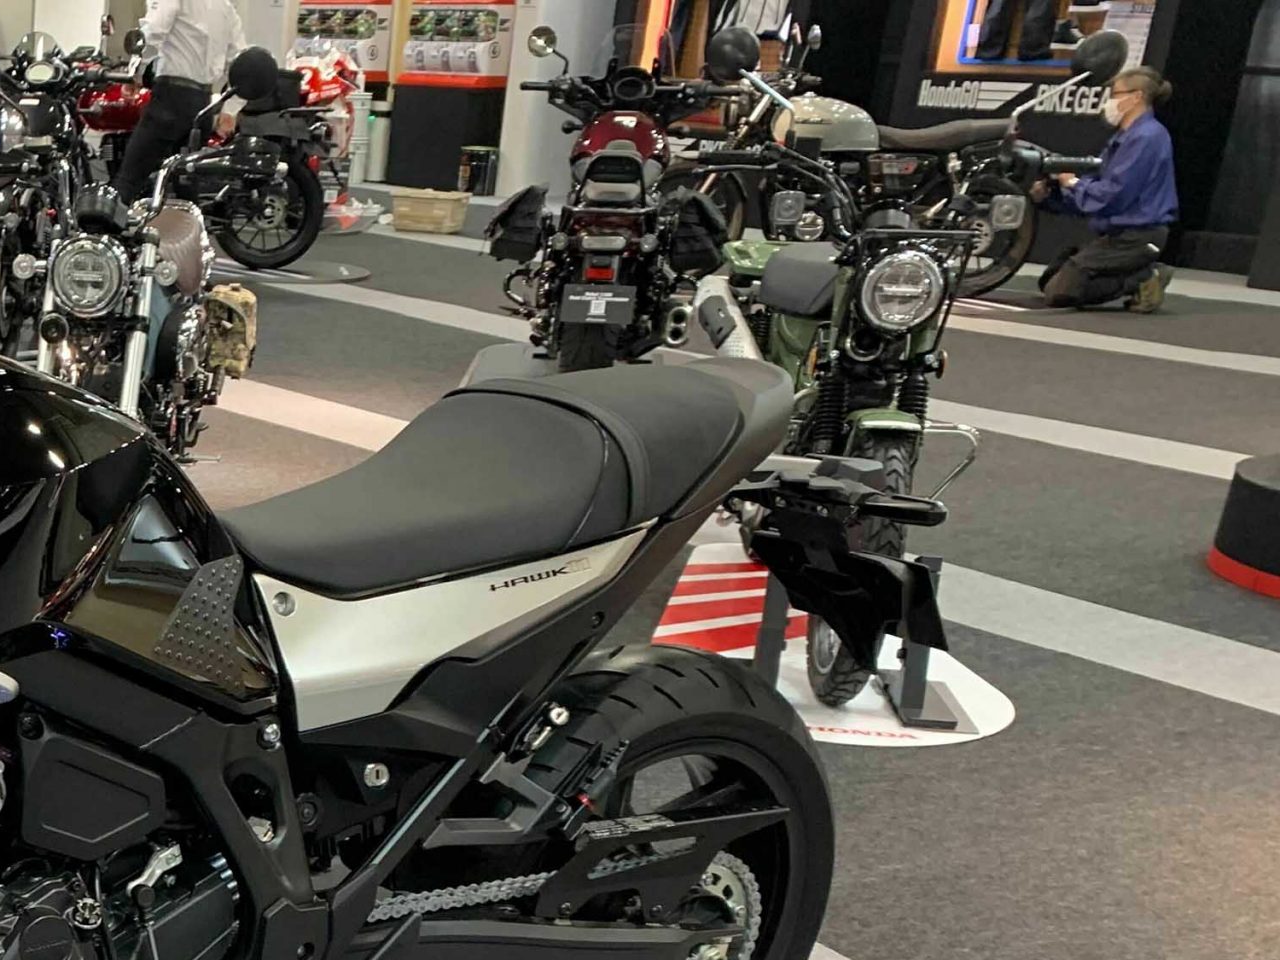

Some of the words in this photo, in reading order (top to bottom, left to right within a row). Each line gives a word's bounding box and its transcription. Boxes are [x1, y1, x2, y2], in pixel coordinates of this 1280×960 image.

[917, 79, 980, 109] HondaGO
[1075, 86, 1111, 114] GEA
[489, 566, 568, 591] HAWK
